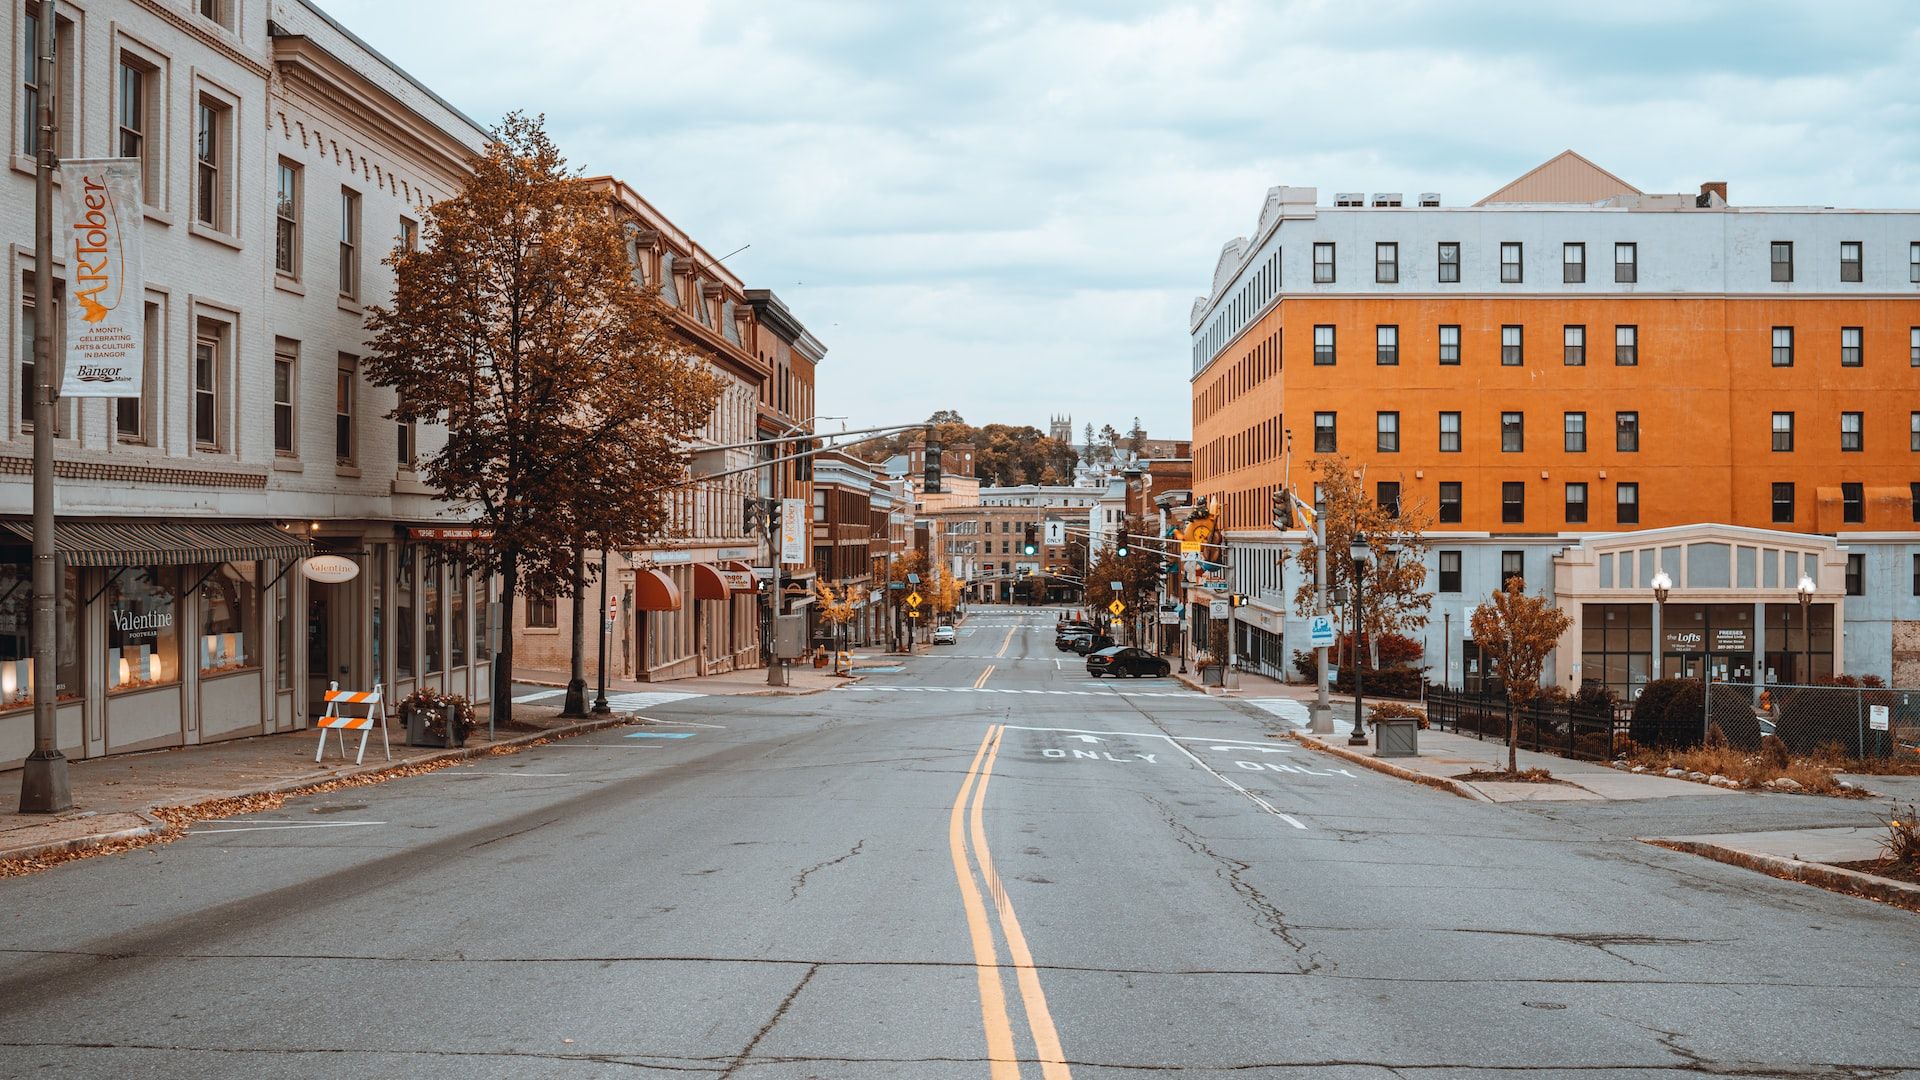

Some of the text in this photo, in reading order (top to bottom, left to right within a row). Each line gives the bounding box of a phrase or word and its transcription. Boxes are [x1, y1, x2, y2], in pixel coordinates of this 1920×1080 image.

[74, 176, 108, 310] ARTober
[77, 365, 122, 380] Bangor
[310, 562, 353, 572] Valentine
[113, 609, 172, 631] Valentine
[1678, 632, 1701, 643] Lofts
[1042, 749, 1157, 763] ONLY
[1235, 761, 1357, 778] ONLY
